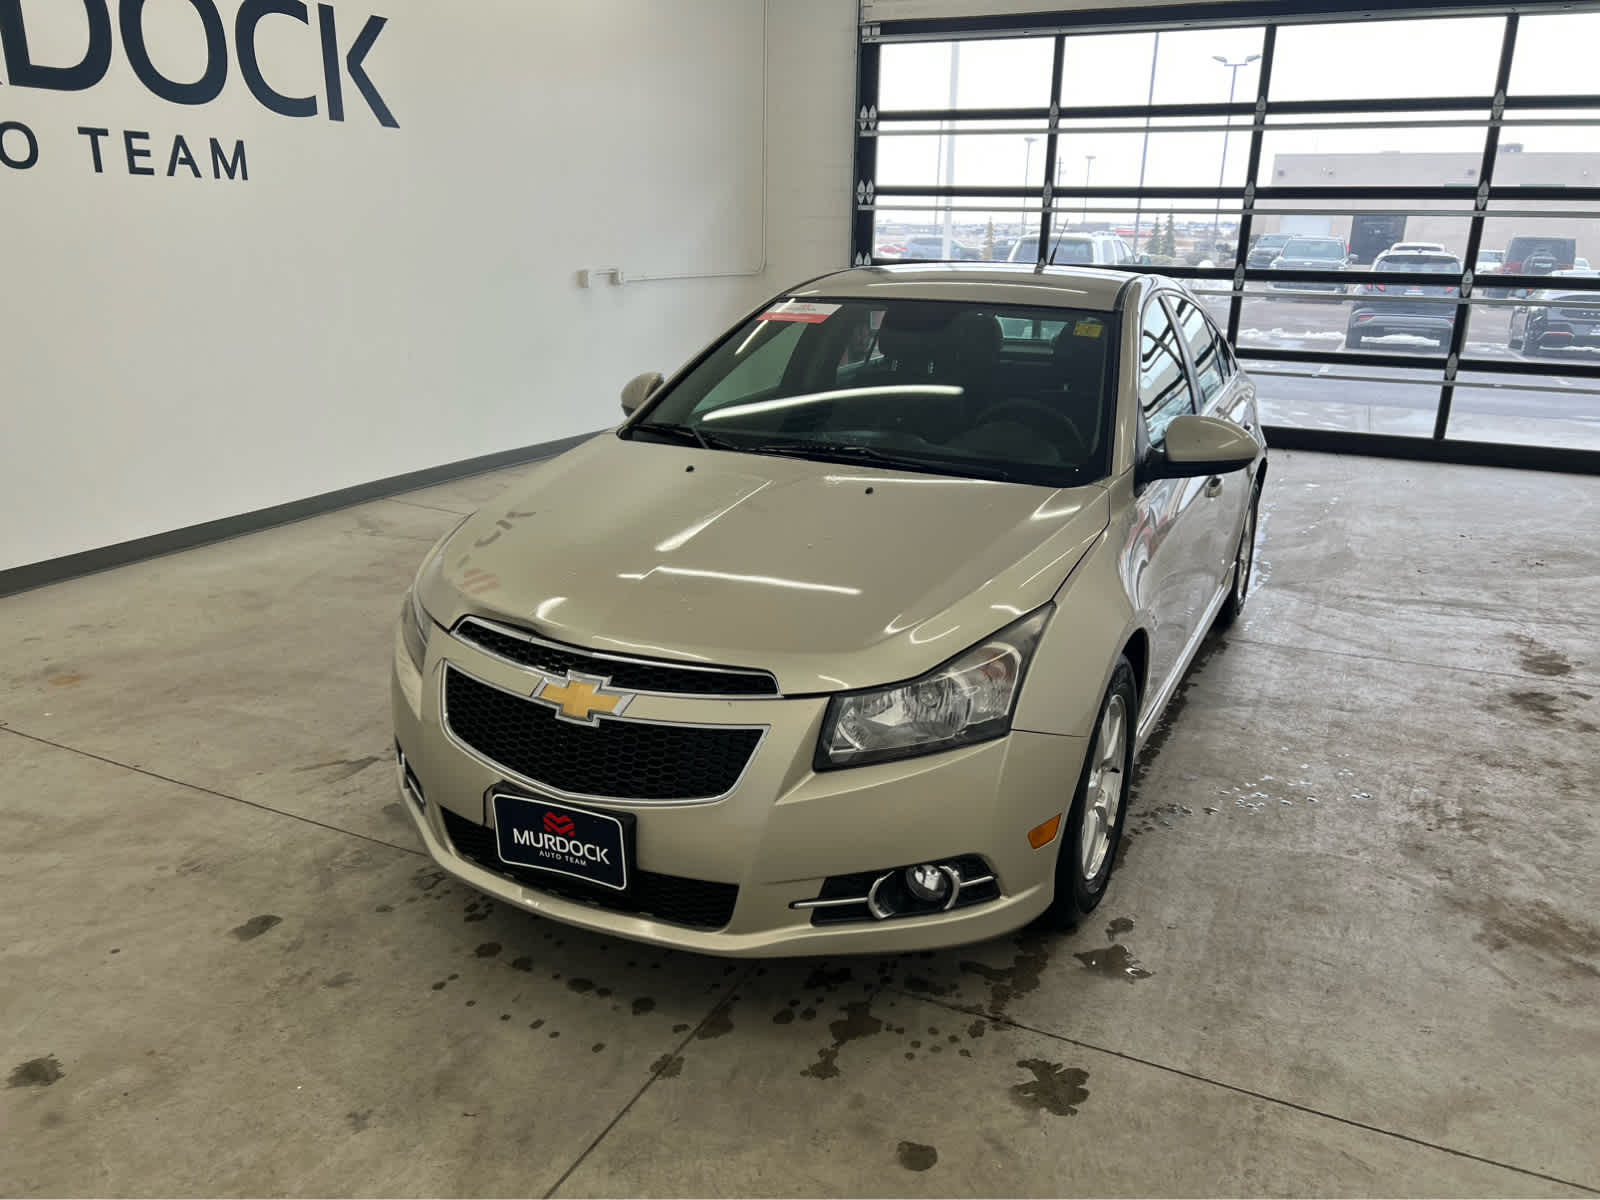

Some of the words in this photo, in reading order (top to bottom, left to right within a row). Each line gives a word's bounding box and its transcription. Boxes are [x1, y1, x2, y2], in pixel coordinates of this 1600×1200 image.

[0, 0, 400, 129] DOCK
[77, 126, 249, 181] TEAM
[513, 828, 610, 865] MURDOCK
[539, 850, 562, 861] AUTO
[565, 855, 587, 866] TEAM
